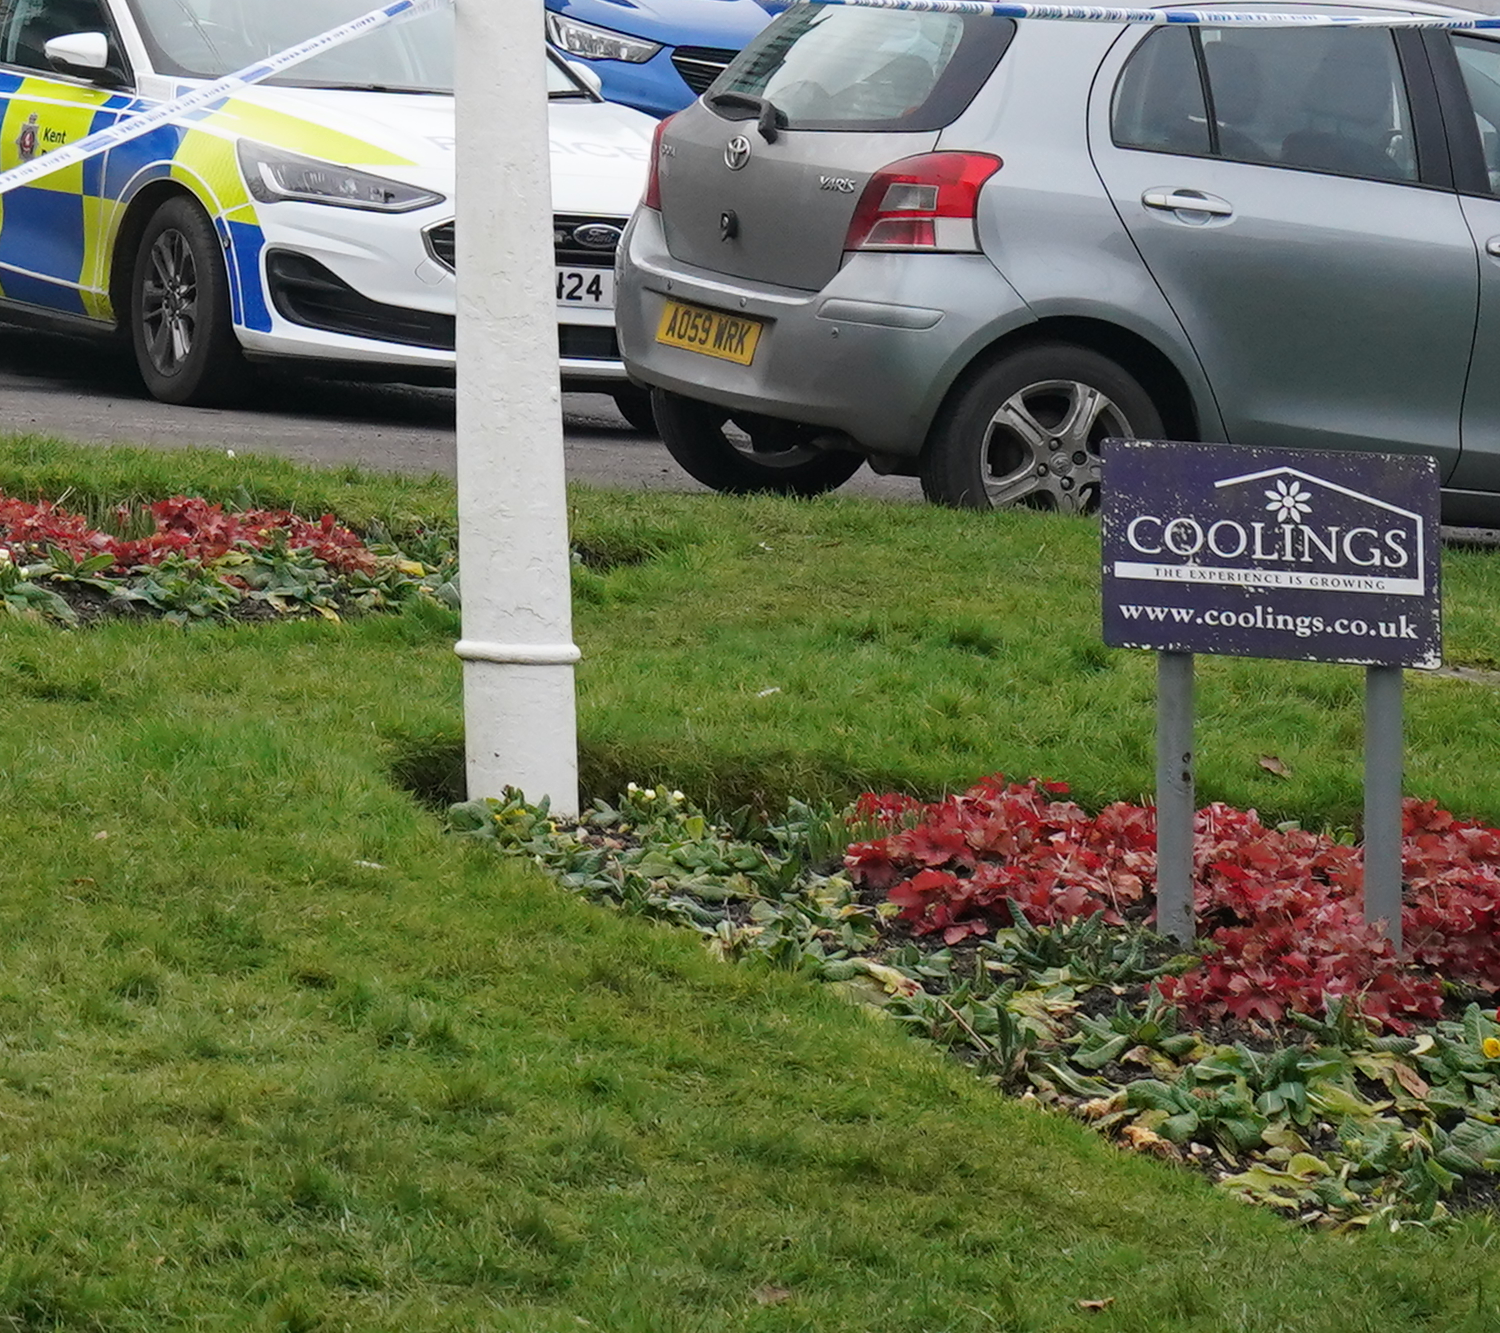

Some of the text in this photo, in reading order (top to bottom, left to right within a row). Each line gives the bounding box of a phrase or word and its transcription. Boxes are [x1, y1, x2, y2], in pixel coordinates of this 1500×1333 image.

[42, 127, 67, 145] Kent
[712, 317, 753, 357] WRK
[1126, 515, 1409, 569] COOLINGS
[1153, 566, 1387, 591] THE EXPERIENCE IS GROWING
[1118, 604, 1419, 640] www.coolings.co.uk
